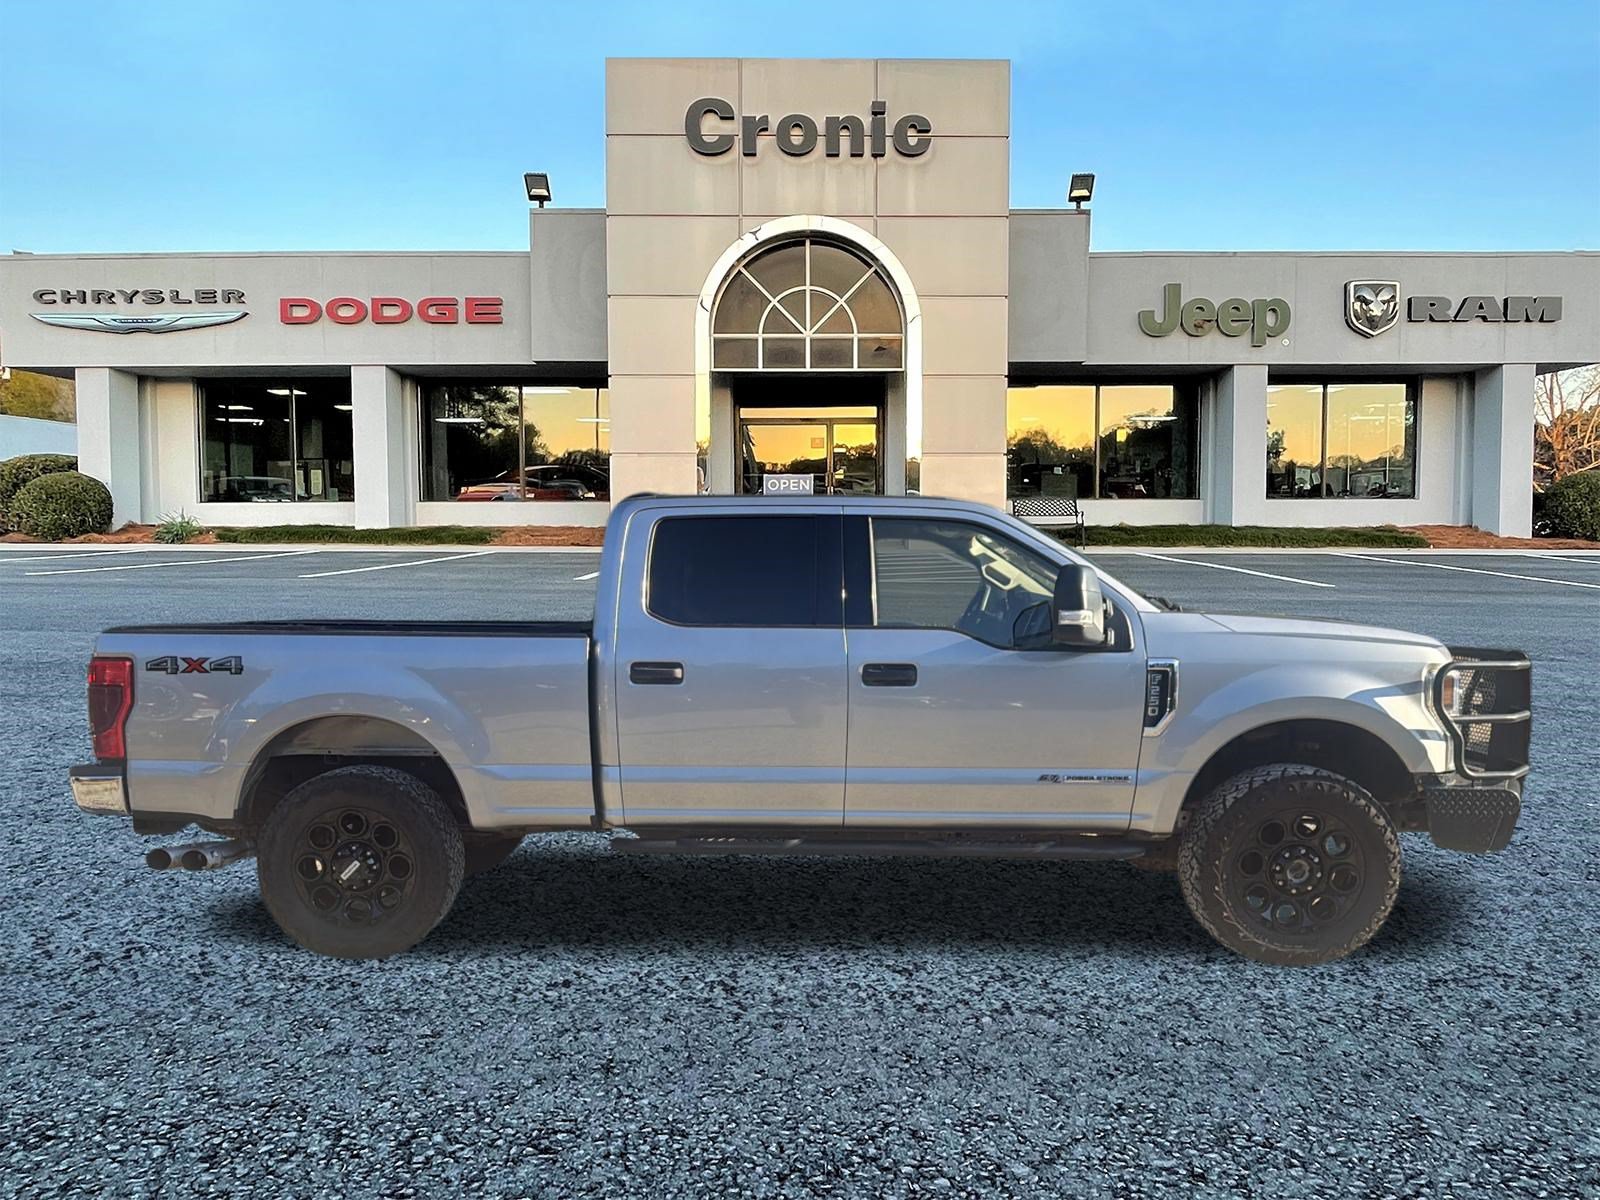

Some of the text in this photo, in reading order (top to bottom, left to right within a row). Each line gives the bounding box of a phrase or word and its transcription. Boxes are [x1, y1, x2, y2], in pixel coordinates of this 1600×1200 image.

[685, 97, 932, 157] Cronic
[32, 288, 247, 305] CHRYSLER
[279, 296, 504, 325] DODGE
[1407, 295, 1563, 323] RAM
[1138, 283, 1292, 347] Jeep
[767, 479, 810, 491] OPEN
